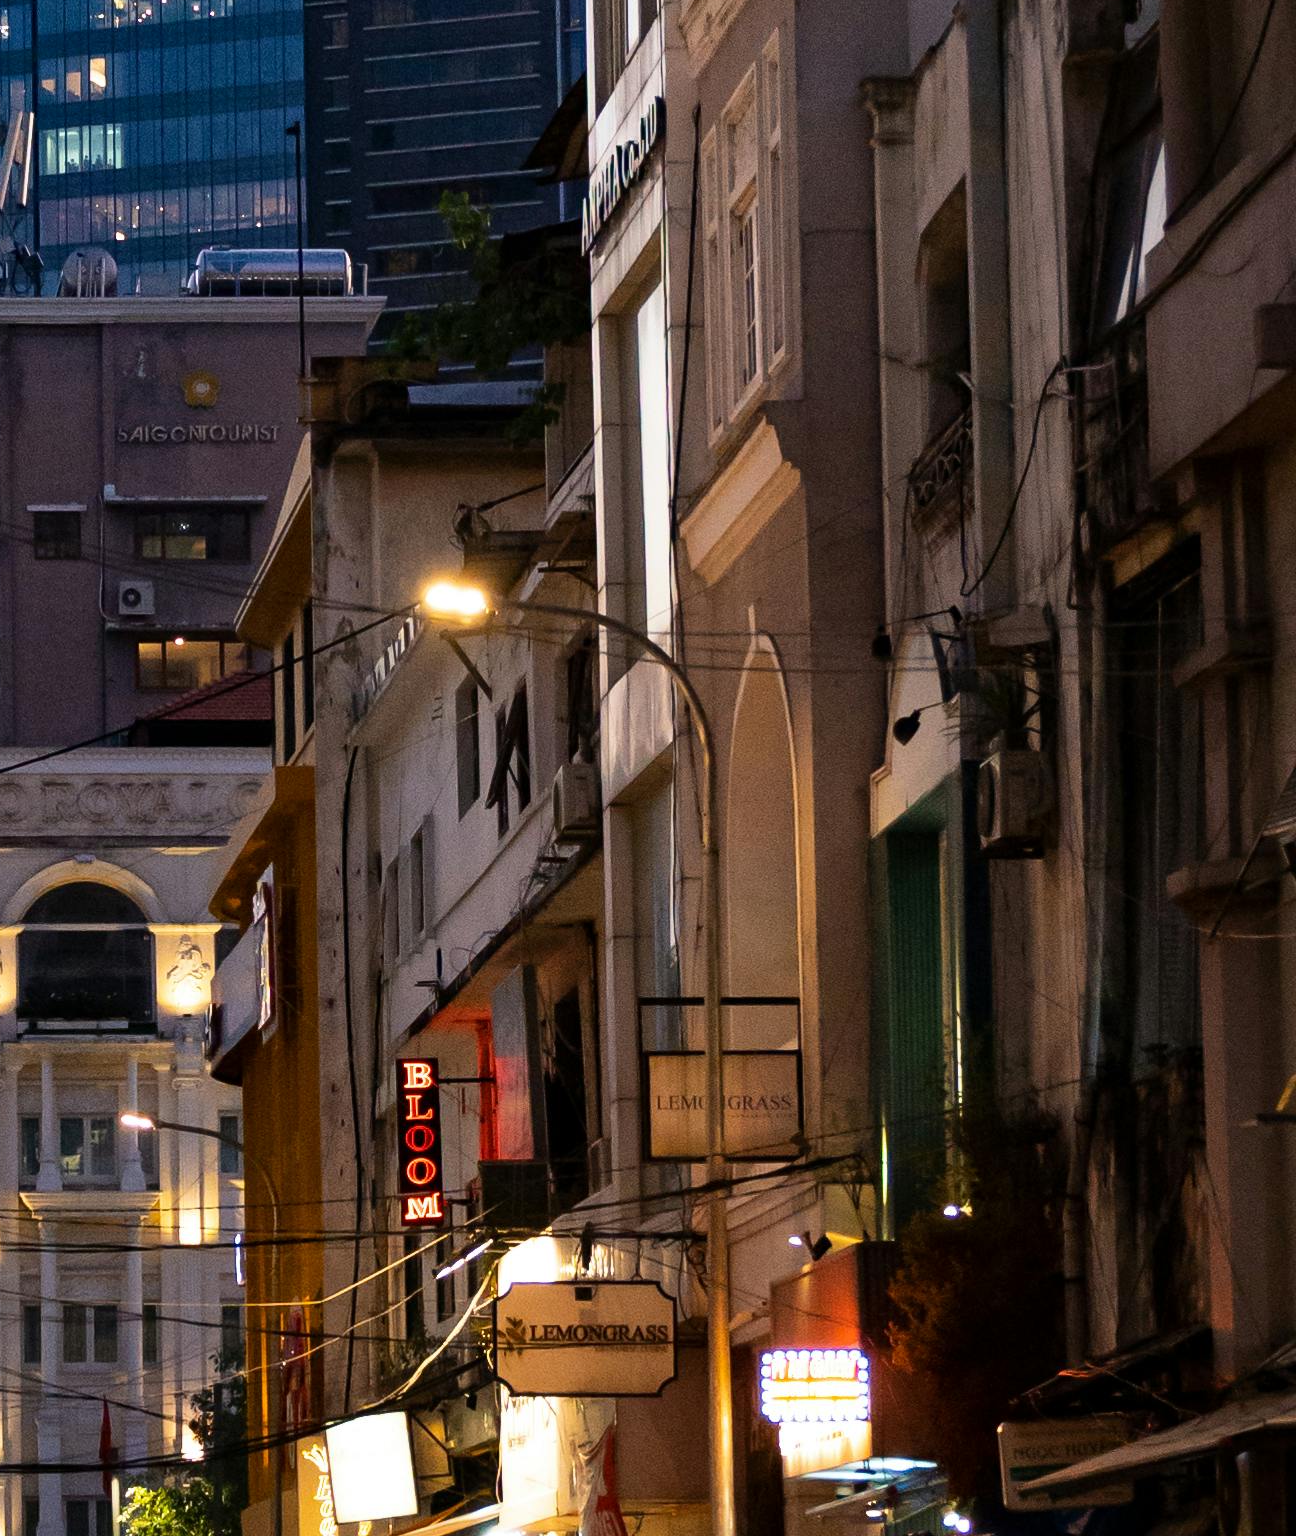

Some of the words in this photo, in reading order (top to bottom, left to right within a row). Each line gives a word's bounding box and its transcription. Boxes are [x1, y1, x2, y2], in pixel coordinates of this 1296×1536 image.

[116, 423, 280, 445] SAIGONTOURIST
[656, 1094, 792, 1111] LEMGRASS
[403, 1062, 443, 1221] BLOOM
[529, 1324, 669, 1343] LEMONGRASS
